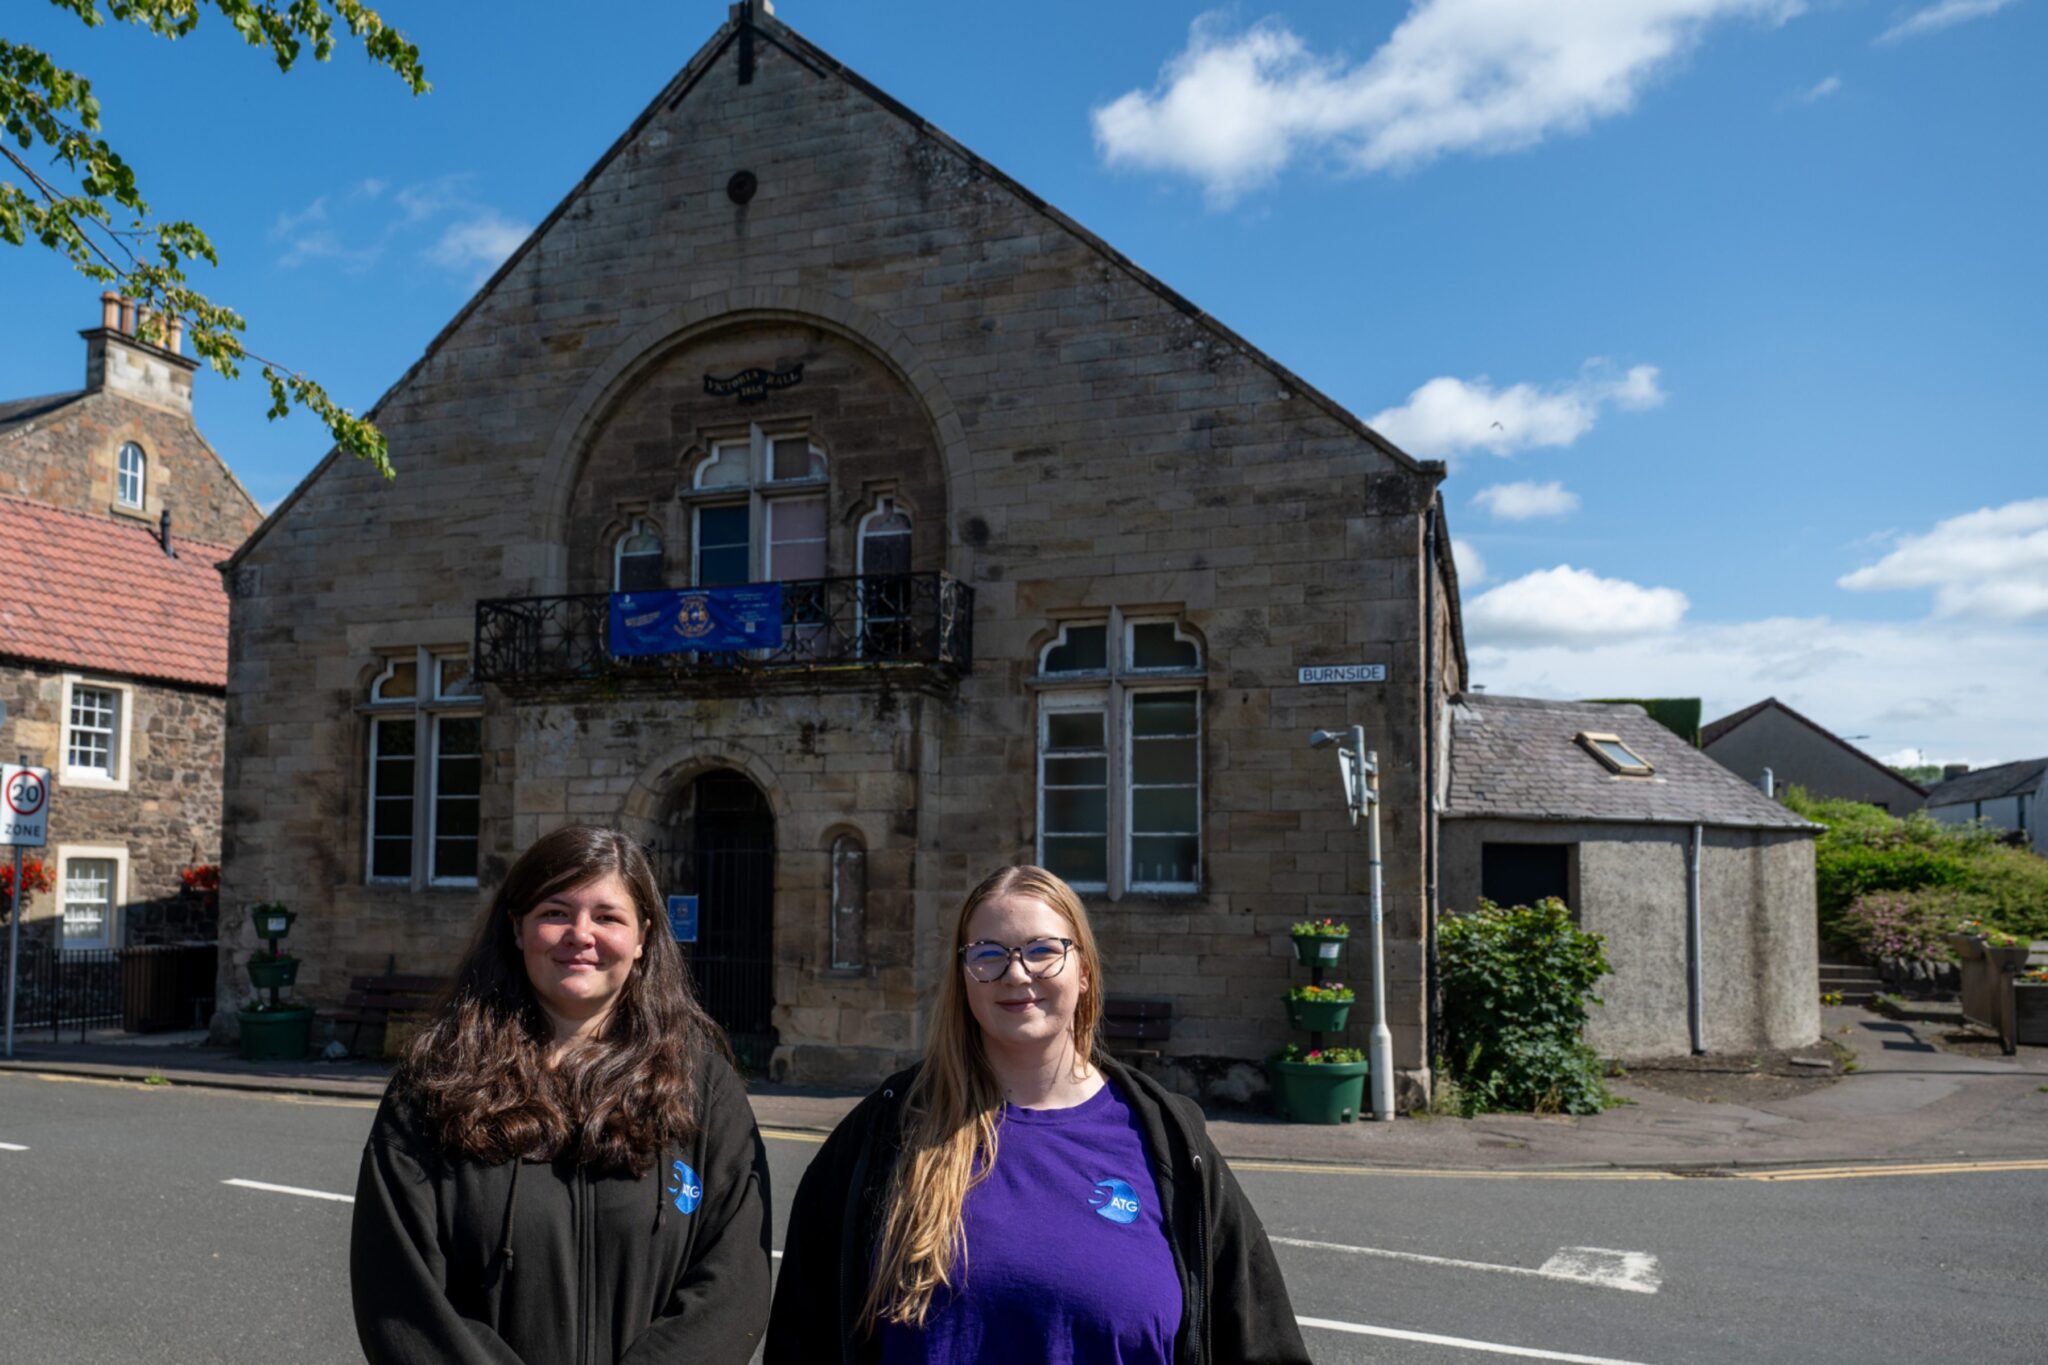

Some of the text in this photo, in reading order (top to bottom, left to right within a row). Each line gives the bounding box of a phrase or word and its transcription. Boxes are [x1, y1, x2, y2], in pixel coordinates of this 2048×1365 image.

[760, 371, 799, 385] HALL
[1303, 666, 1380, 681] BURNSIDE
[12, 784, 39, 803] 20
[5, 823, 41, 837] ZONE
[1110, 1197, 1138, 1213] ATG
